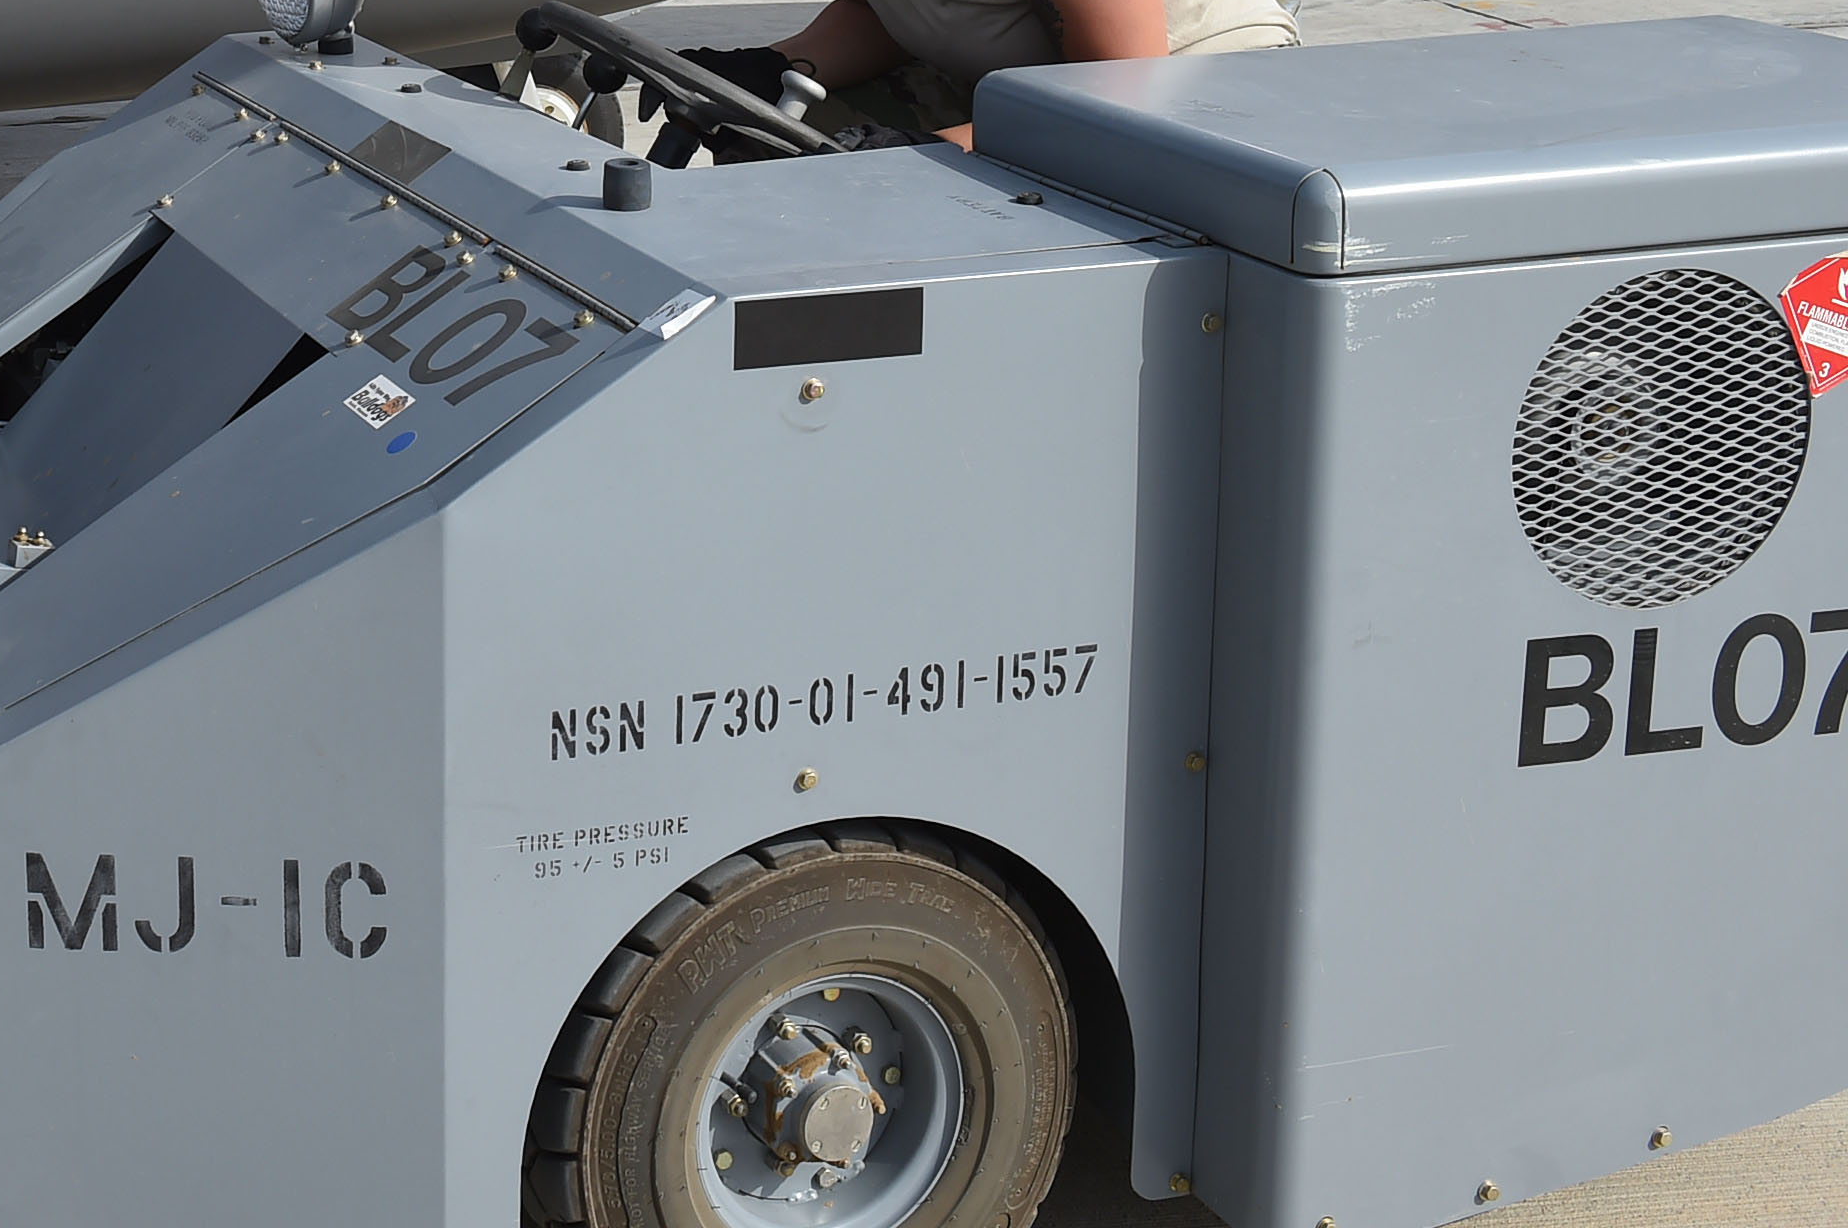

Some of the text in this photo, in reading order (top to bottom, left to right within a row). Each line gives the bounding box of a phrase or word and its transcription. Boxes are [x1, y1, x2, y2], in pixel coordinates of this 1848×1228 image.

[327, 245, 580, 406] BL07
[1796, 300, 1848, 331] FLAMMABL
[1818, 362, 1831, 378] 3
[551, 644, 1099, 761] NSN 1730-01-491-1557
[1518, 609, 1848, 768] BL07
[516, 816, 690, 854] TIRE PRESSURE
[534, 858, 563, 880] 95
[612, 851, 626, 870] 5
[634, 846, 671, 869] PSI
[25, 852, 388, 960] MJ-1C
[846, 876, 898, 902] WIDE
